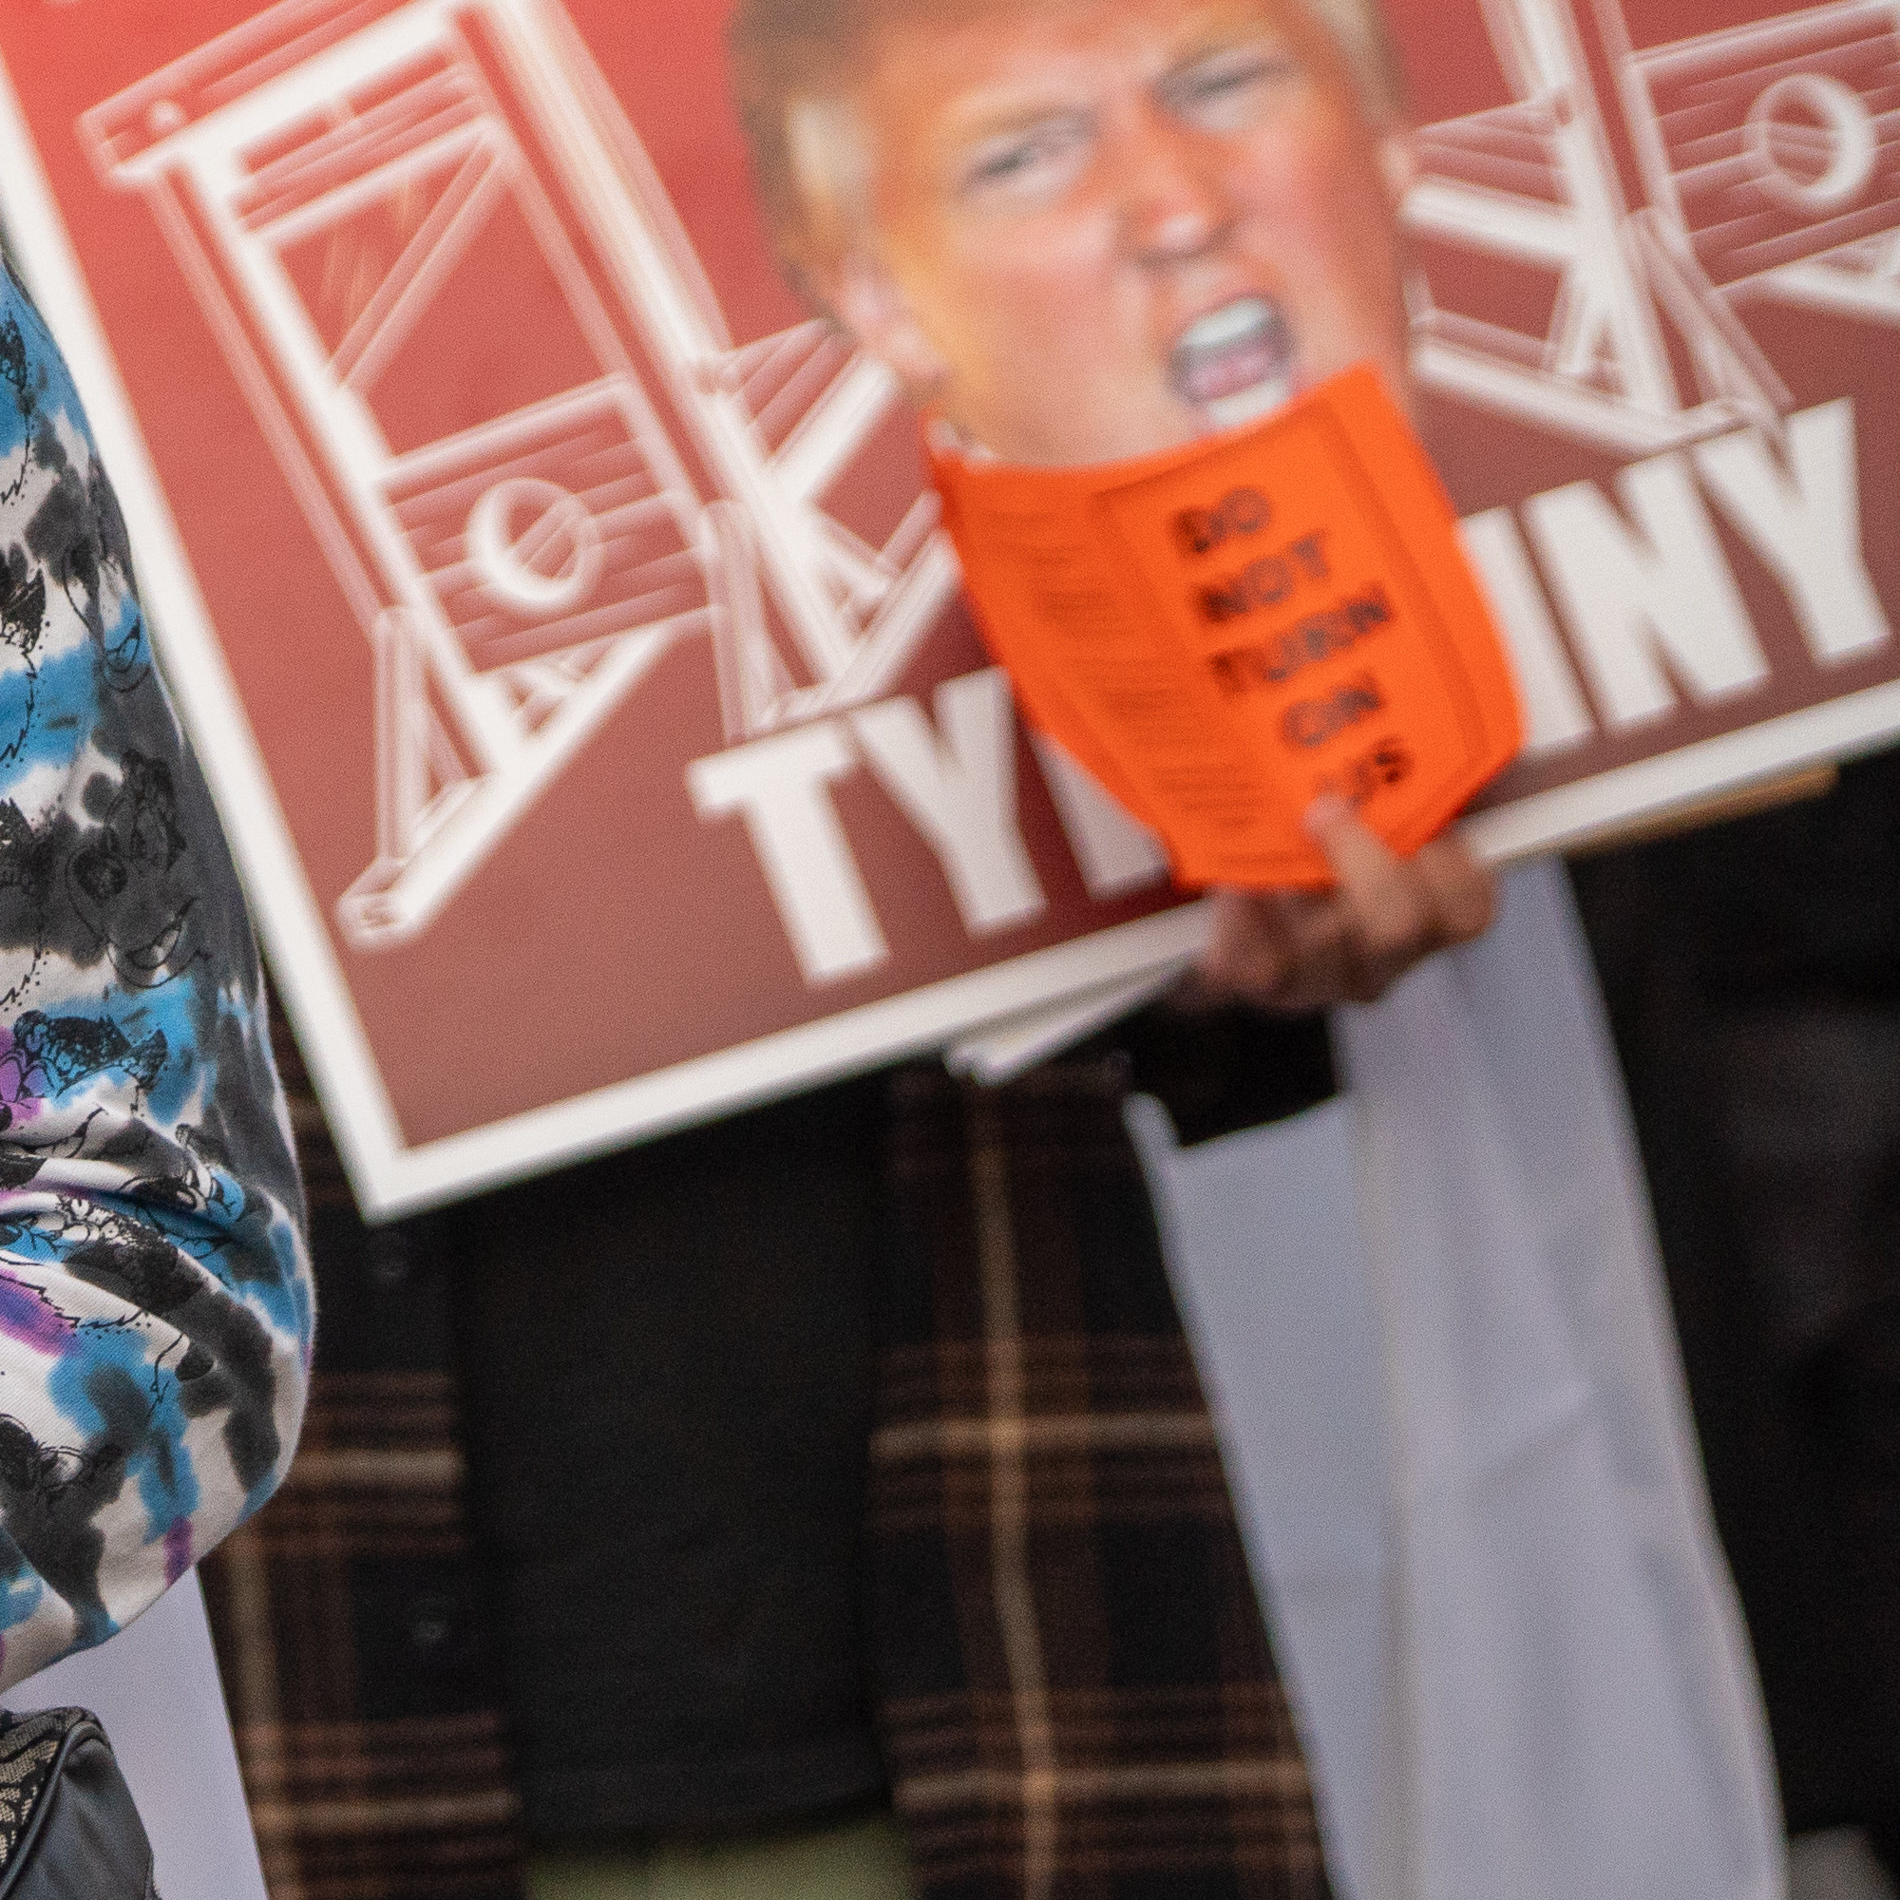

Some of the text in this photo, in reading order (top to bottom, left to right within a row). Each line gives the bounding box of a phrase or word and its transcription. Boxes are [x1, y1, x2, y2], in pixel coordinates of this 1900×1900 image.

[1172, 487, 1272, 556] DO
[1194, 529, 1330, 624] NOT
[1210, 582, 1392, 696] TURN
[690, 398, 1884, 982] TYNY
[1280, 672, 1382, 749] ON
